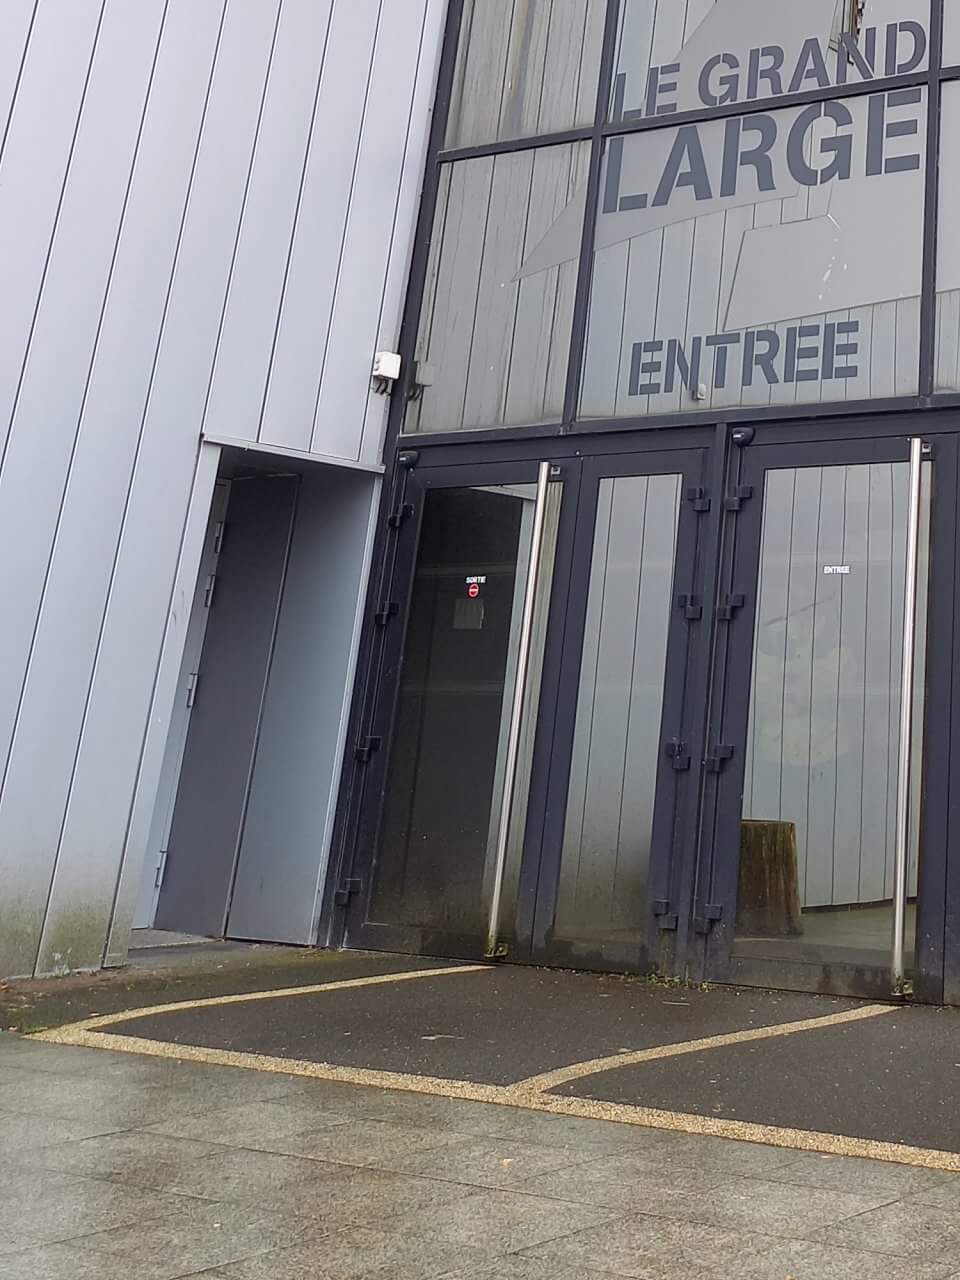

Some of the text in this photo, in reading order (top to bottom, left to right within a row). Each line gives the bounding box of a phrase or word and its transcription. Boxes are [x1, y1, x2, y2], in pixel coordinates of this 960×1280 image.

[614, 21, 926, 120] LE GRAND
[602, 88, 921, 213] LARGE
[628, 320, 859, 397] ENTREE
